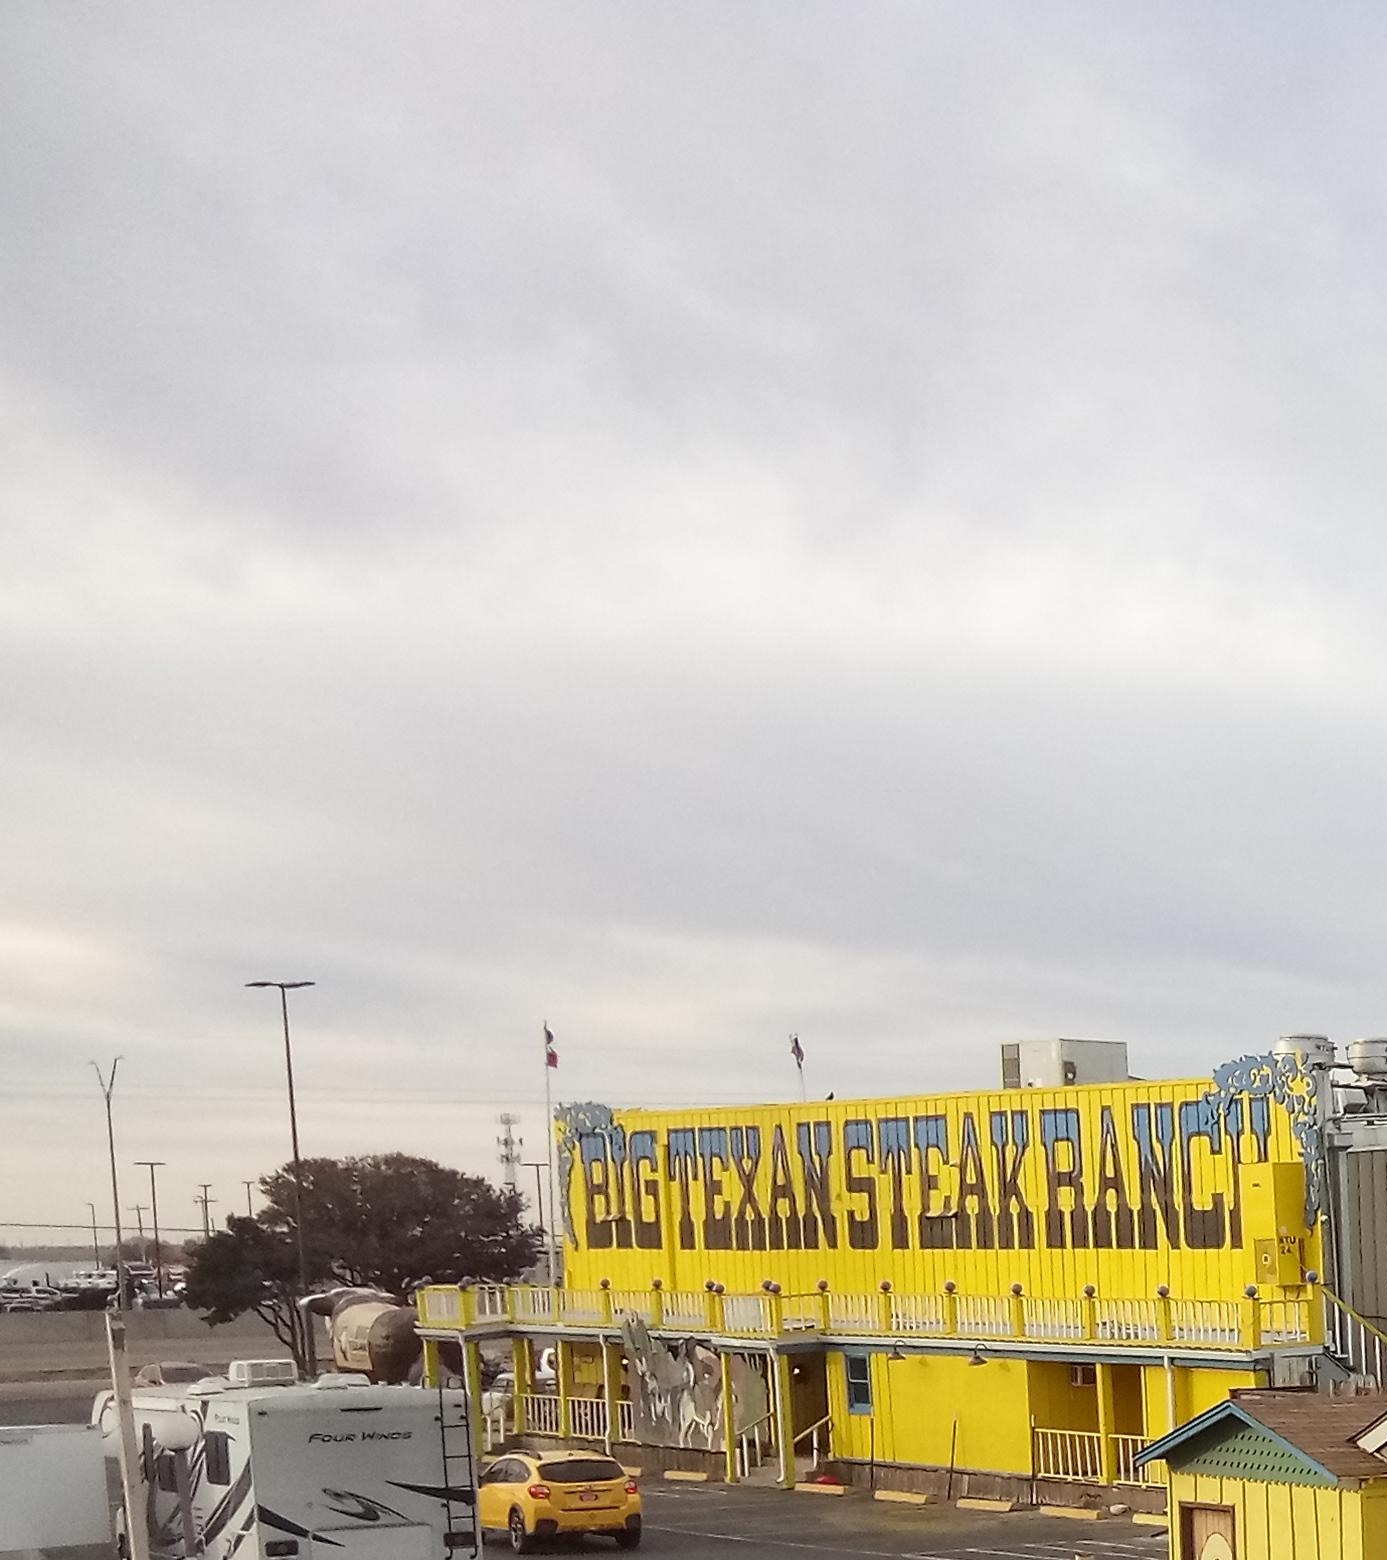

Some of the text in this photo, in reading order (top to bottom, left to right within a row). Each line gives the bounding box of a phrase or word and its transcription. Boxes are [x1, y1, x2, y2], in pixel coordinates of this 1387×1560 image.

[579, 1128, 663, 1250] BIG
[667, 1120, 838, 1251] TEXAN
[843, 1107, 1034, 1250] STEAK
[308, 1432, 356, 1443] FOUR
